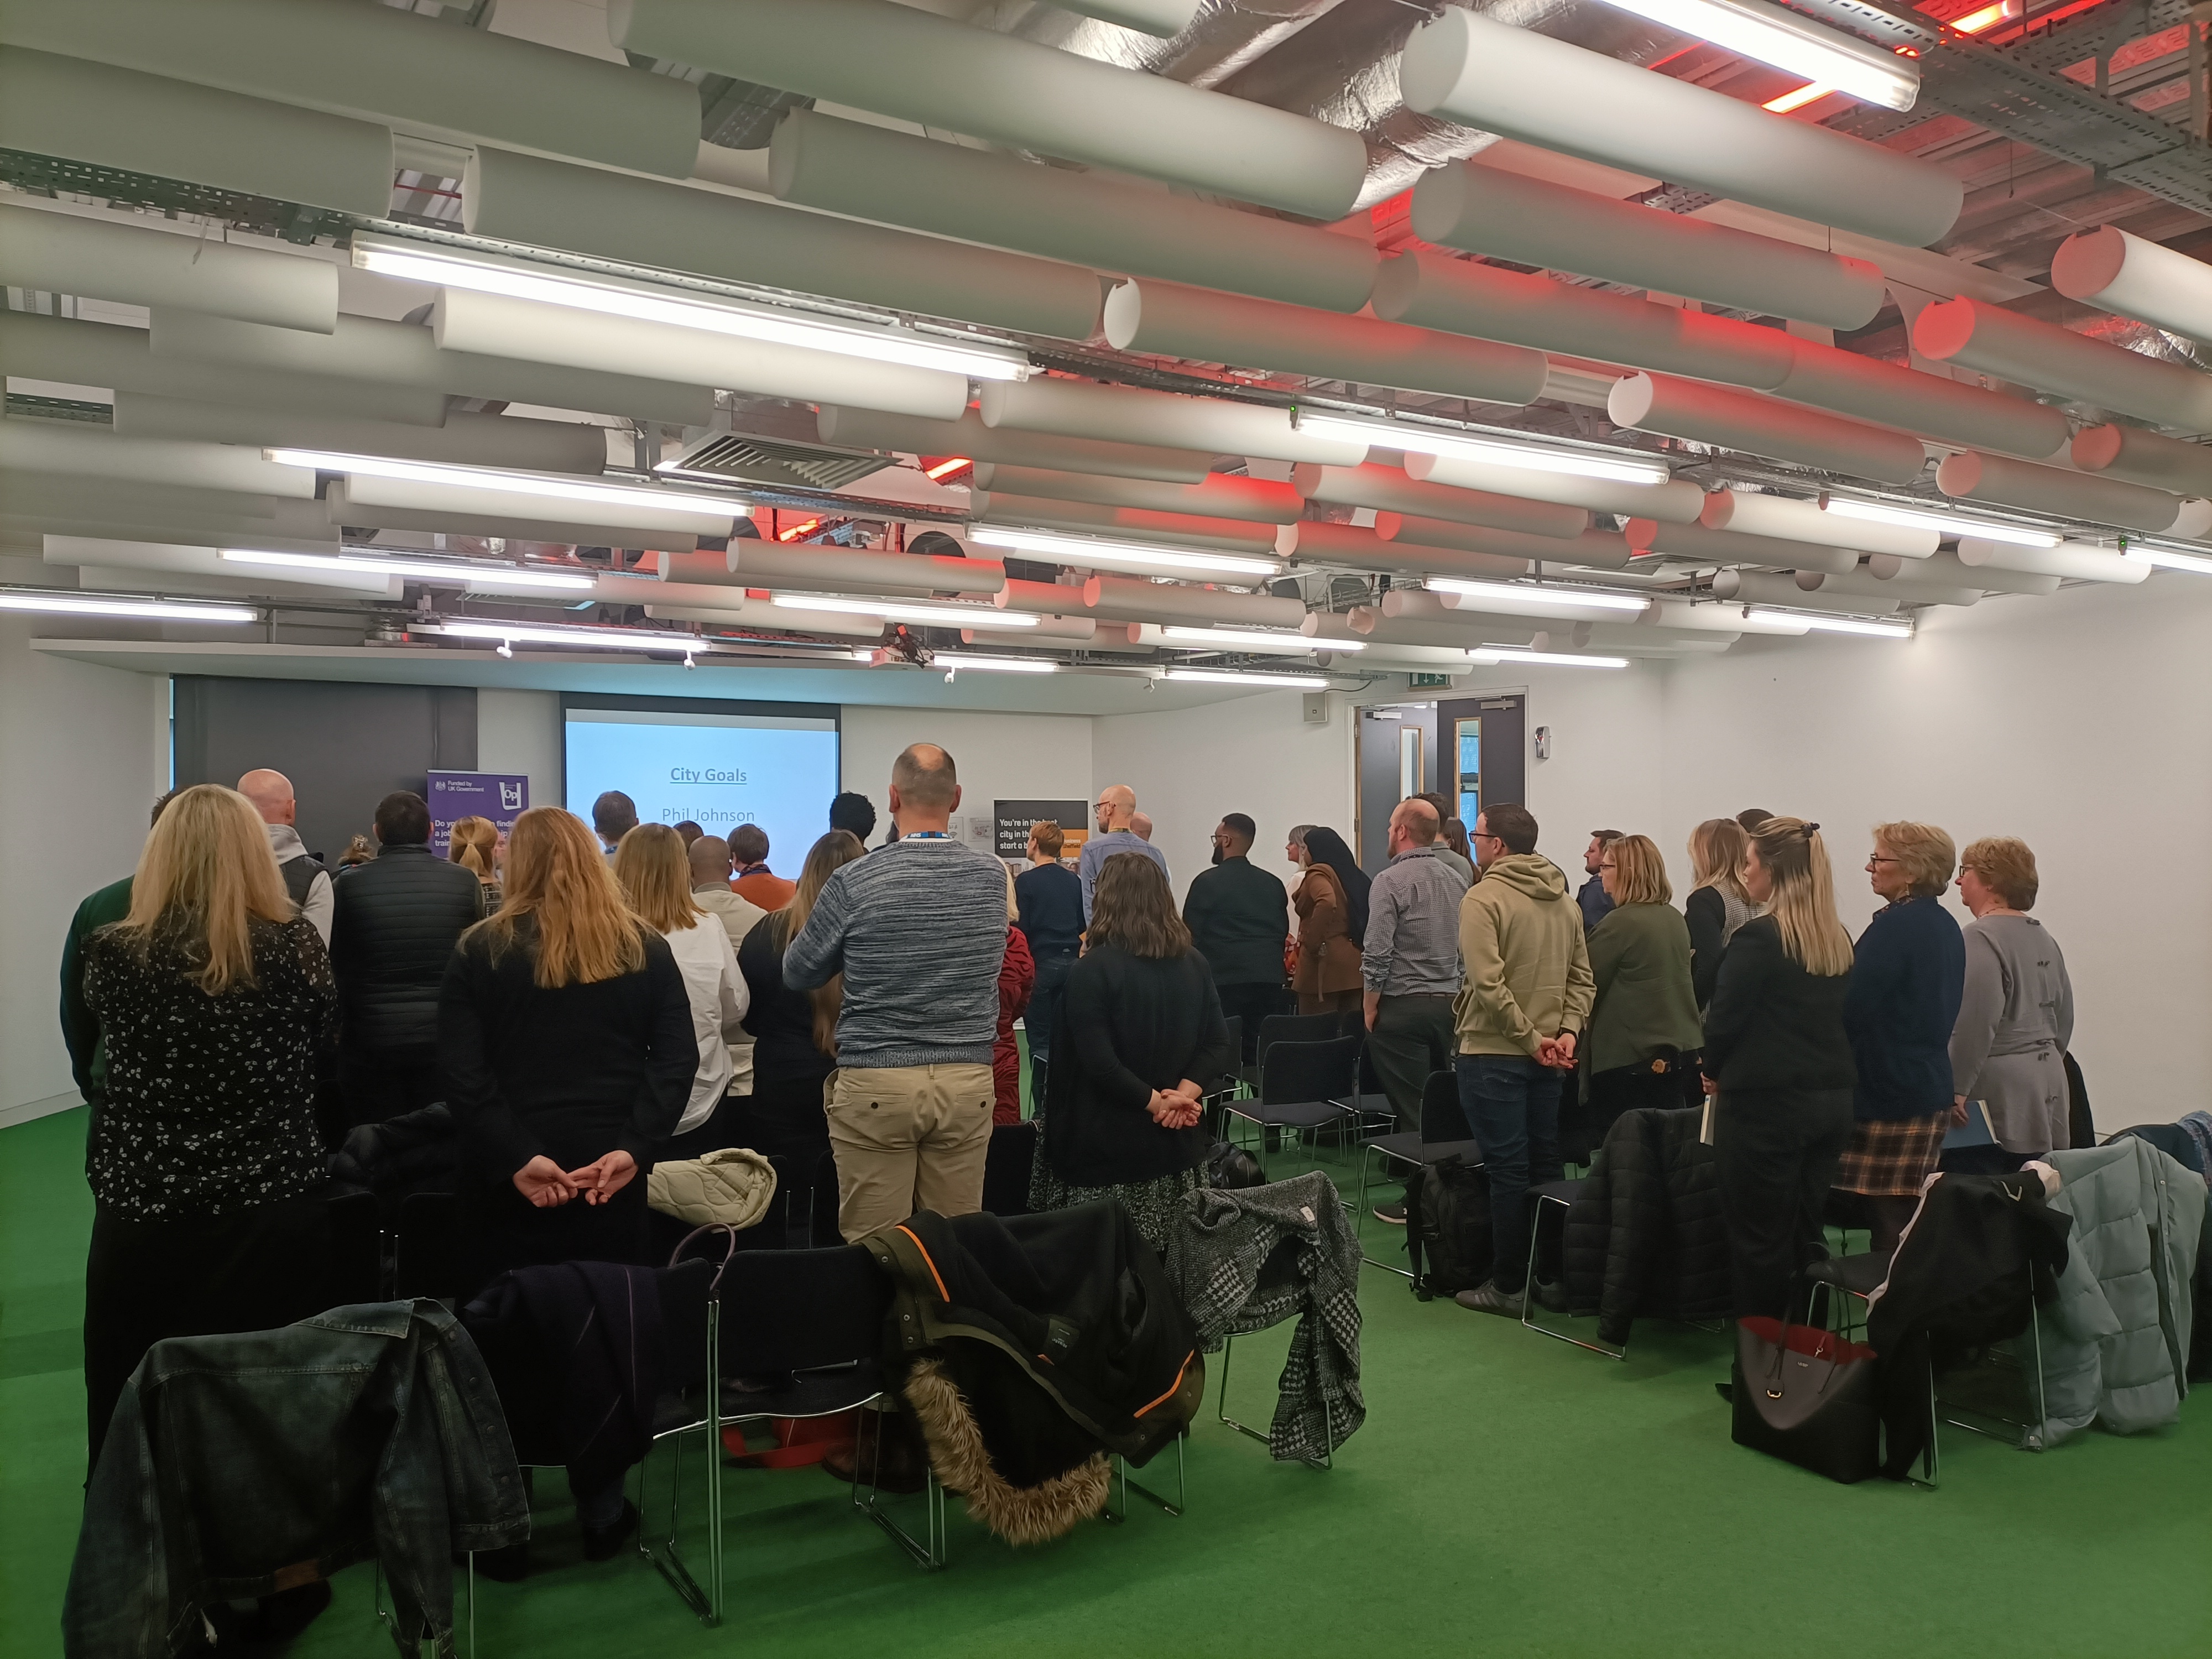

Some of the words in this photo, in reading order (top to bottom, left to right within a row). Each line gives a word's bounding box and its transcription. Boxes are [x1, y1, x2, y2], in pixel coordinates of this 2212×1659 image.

[670, 768, 700, 784] City
[705, 768, 747, 782] Goals
[662, 808, 689, 821] Phil
[693, 808, 754, 822] Johnson
[999, 818, 1021, 827] You're
[1022, 818, 1029, 827] in
[999, 830, 1013, 840] city
